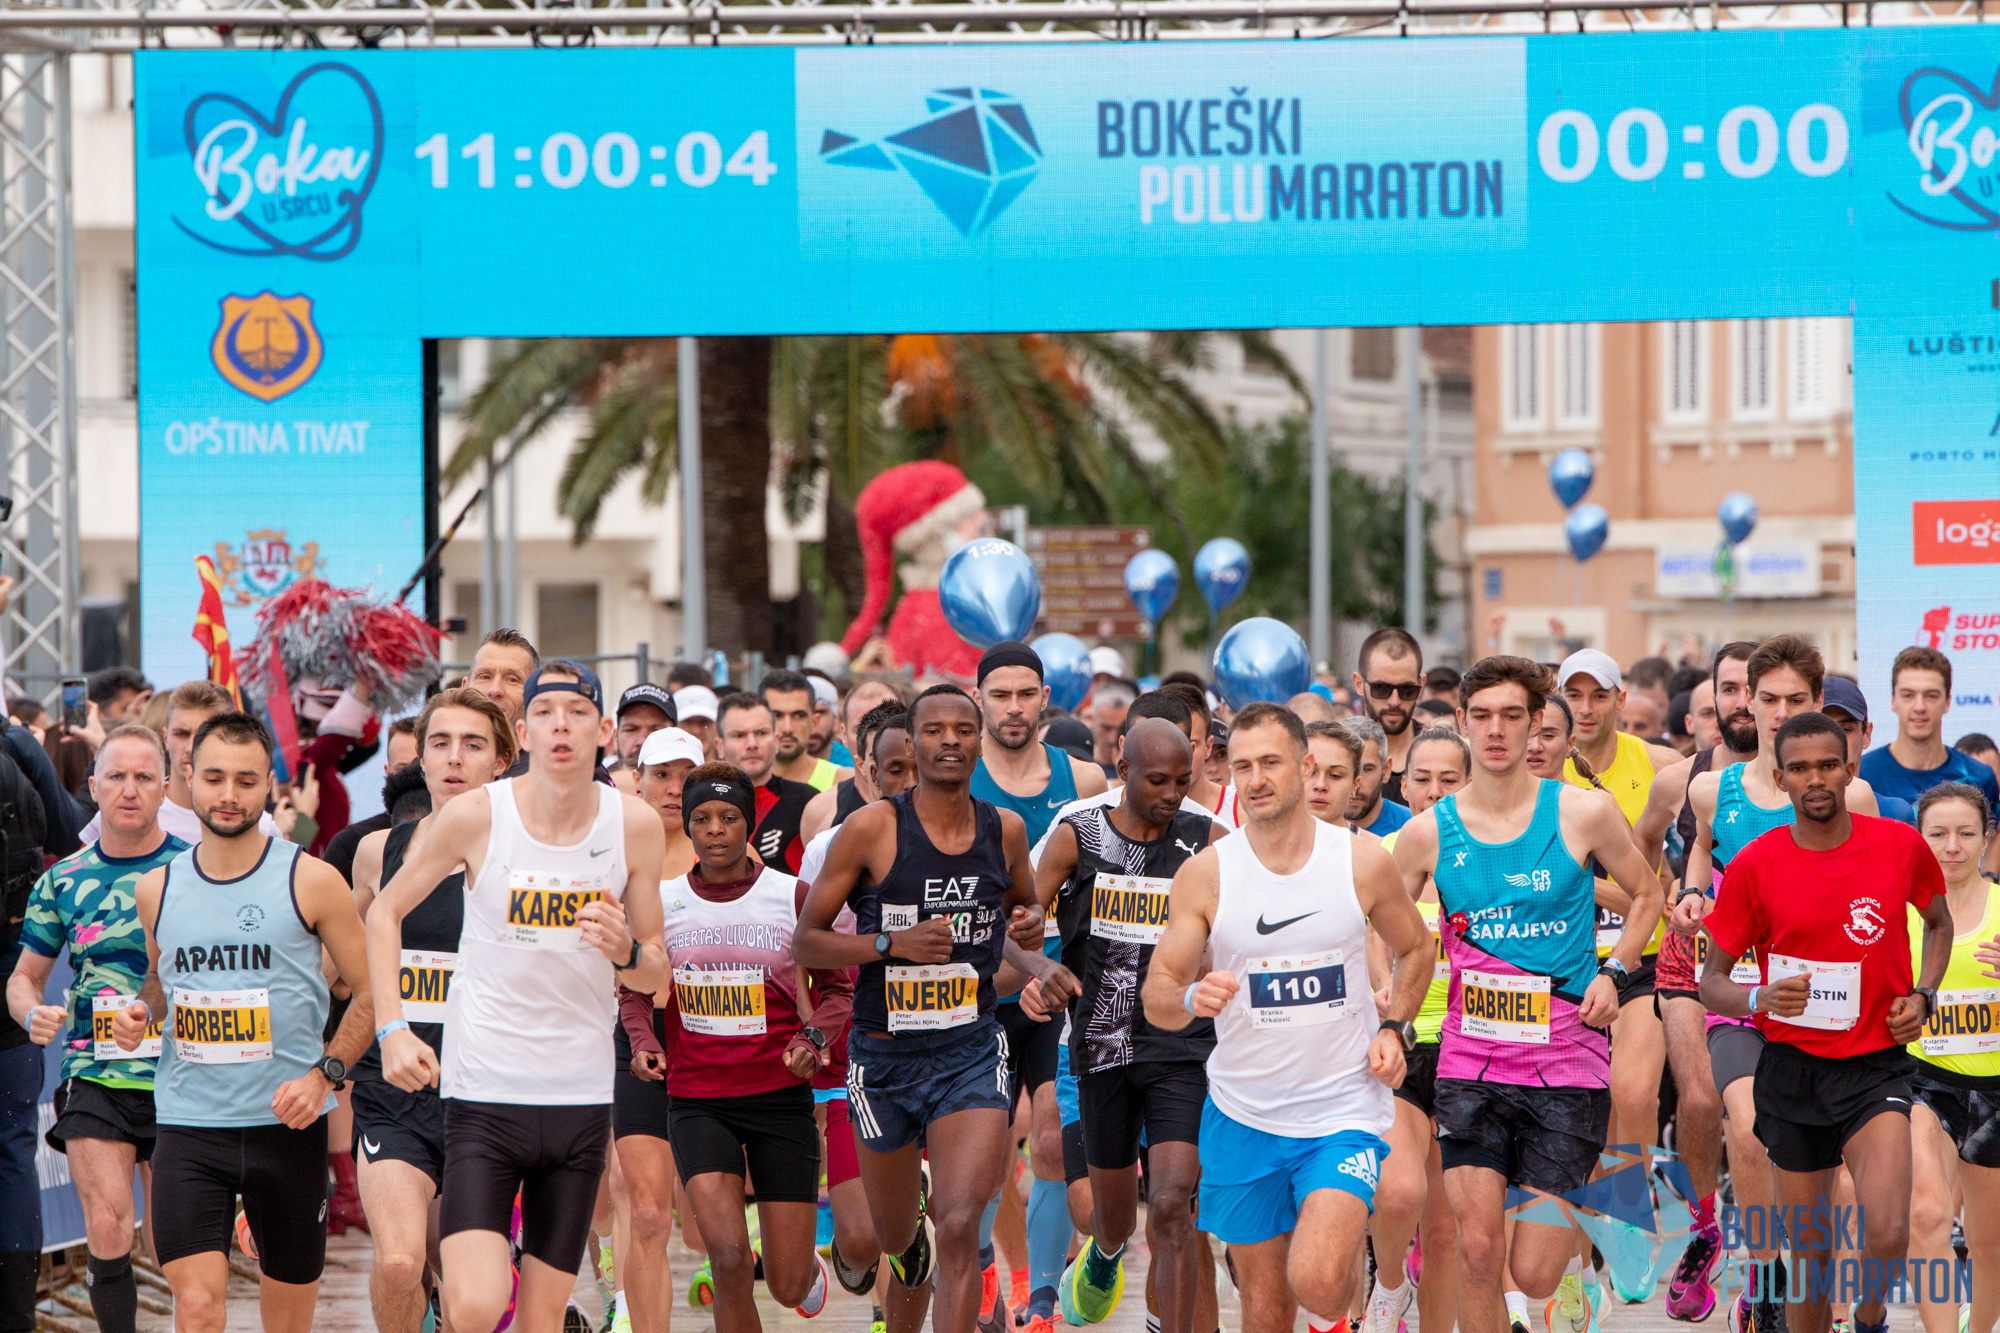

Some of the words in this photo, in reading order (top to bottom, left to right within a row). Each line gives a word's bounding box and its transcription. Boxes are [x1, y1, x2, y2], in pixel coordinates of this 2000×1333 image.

[1098, 87, 1301, 158] BOKEŠKI
[1537, 103, 1849, 183] 00:00
[194, 117, 370, 221] Boka
[415, 130, 777, 189] 11:00:04
[1140, 160, 1503, 224] POLUMARATON
[262, 201, 277, 224] U
[281, 193, 332, 221] SRCU
[1908, 331, 2000, 354] LUŠTI
[165, 417, 288, 456] OPŠTINA
[294, 421, 370, 454] TIVAT
[1911, 451, 1974, 462] PORTO
[967, 541, 1015, 559] 1:30
[1532, 870, 1551, 882] CR
[924, 876, 980, 902] EA7
[1533, 881, 1552, 891] 387
[924, 901, 950, 910] EMPORIO
[1849, 897, 1881, 910] ATLETICA
[889, 913, 911, 927] JBL
[1469, 905, 1513, 923] VISIT
[516, 927, 538, 935] Gábor
[1099, 921, 1123, 930] Bernard
[1099, 928, 1117, 936] Musau
[1119, 931, 1145, 939] Wambua
[1470, 920, 1568, 940] SARAJEVO
[1843, 923, 1864, 946] SANDRO
[1865, 927, 1886, 946] CALVESI
[515, 935, 539, 943] Karsai
[670, 925, 723, 949] LIBERTAS
[726, 923, 783, 952] LIVORNO
[174, 943, 271, 973] APATIN
[888, 978, 966, 1011] NJERU
[1267, 976, 1321, 1001] 110
[677, 984, 753, 1016] NAKIMANA
[1465, 986, 1537, 1023] GABRIEL
[176, 1006, 256, 1042] BORBELJ
[685, 1015, 708, 1024] Cavaline
[896, 1018, 921, 1026] Mwaniki
[922, 1018, 940, 1026] Njeru
[1261, 1016, 1291, 1024] Krkalović
[1469, 1018, 1488, 1028] Gabriel
[1468, 1025, 1497, 1036] Greenwich
[183, 1050, 203, 1060] Borbelj
